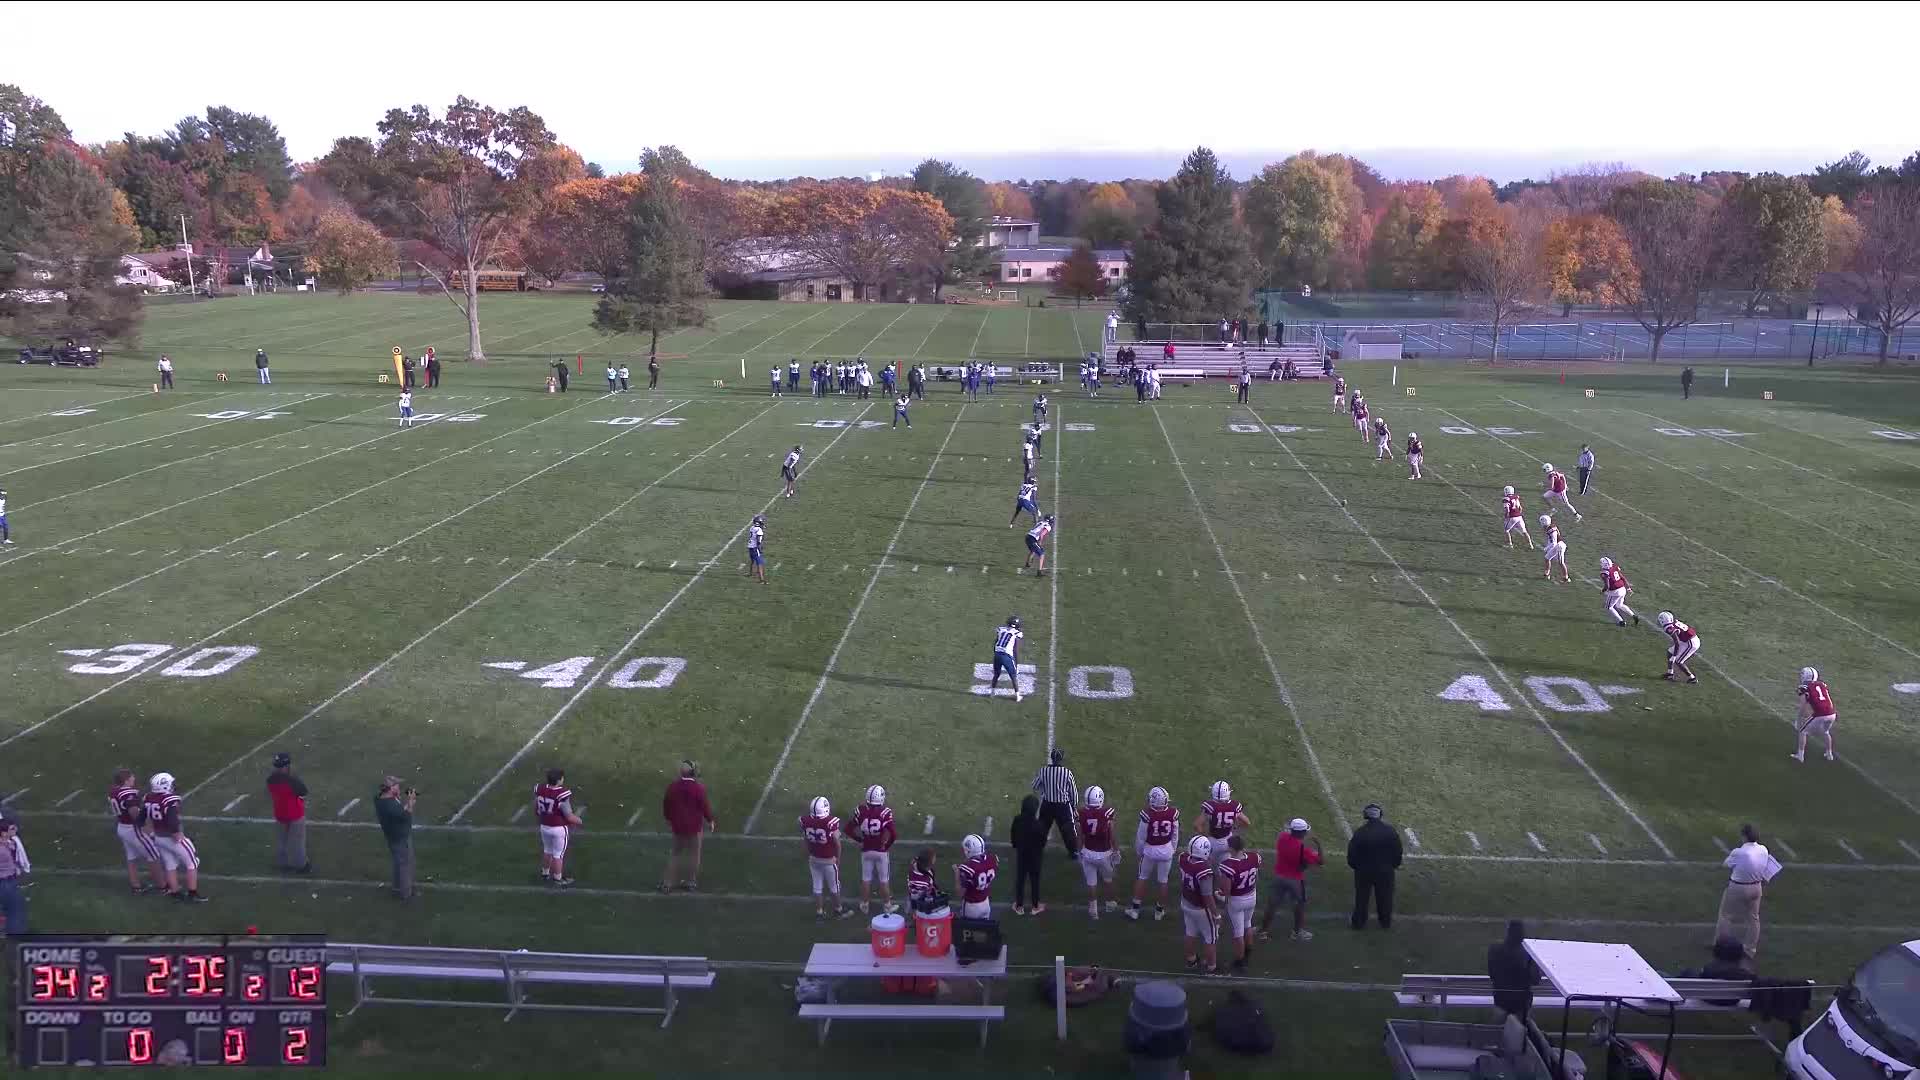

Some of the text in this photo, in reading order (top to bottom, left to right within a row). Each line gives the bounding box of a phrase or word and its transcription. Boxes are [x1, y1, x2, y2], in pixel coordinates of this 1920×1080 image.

[519, 655, 688, 689] 40
[969, 662, 1134, 698] 50
[1437, 674, 1612, 712] 40
[861, 817, 881, 836] 42
[1086, 818, 1098, 836] 7
[1152, 820, 1172, 837] 13
[1216, 811, 1235, 829] 15
